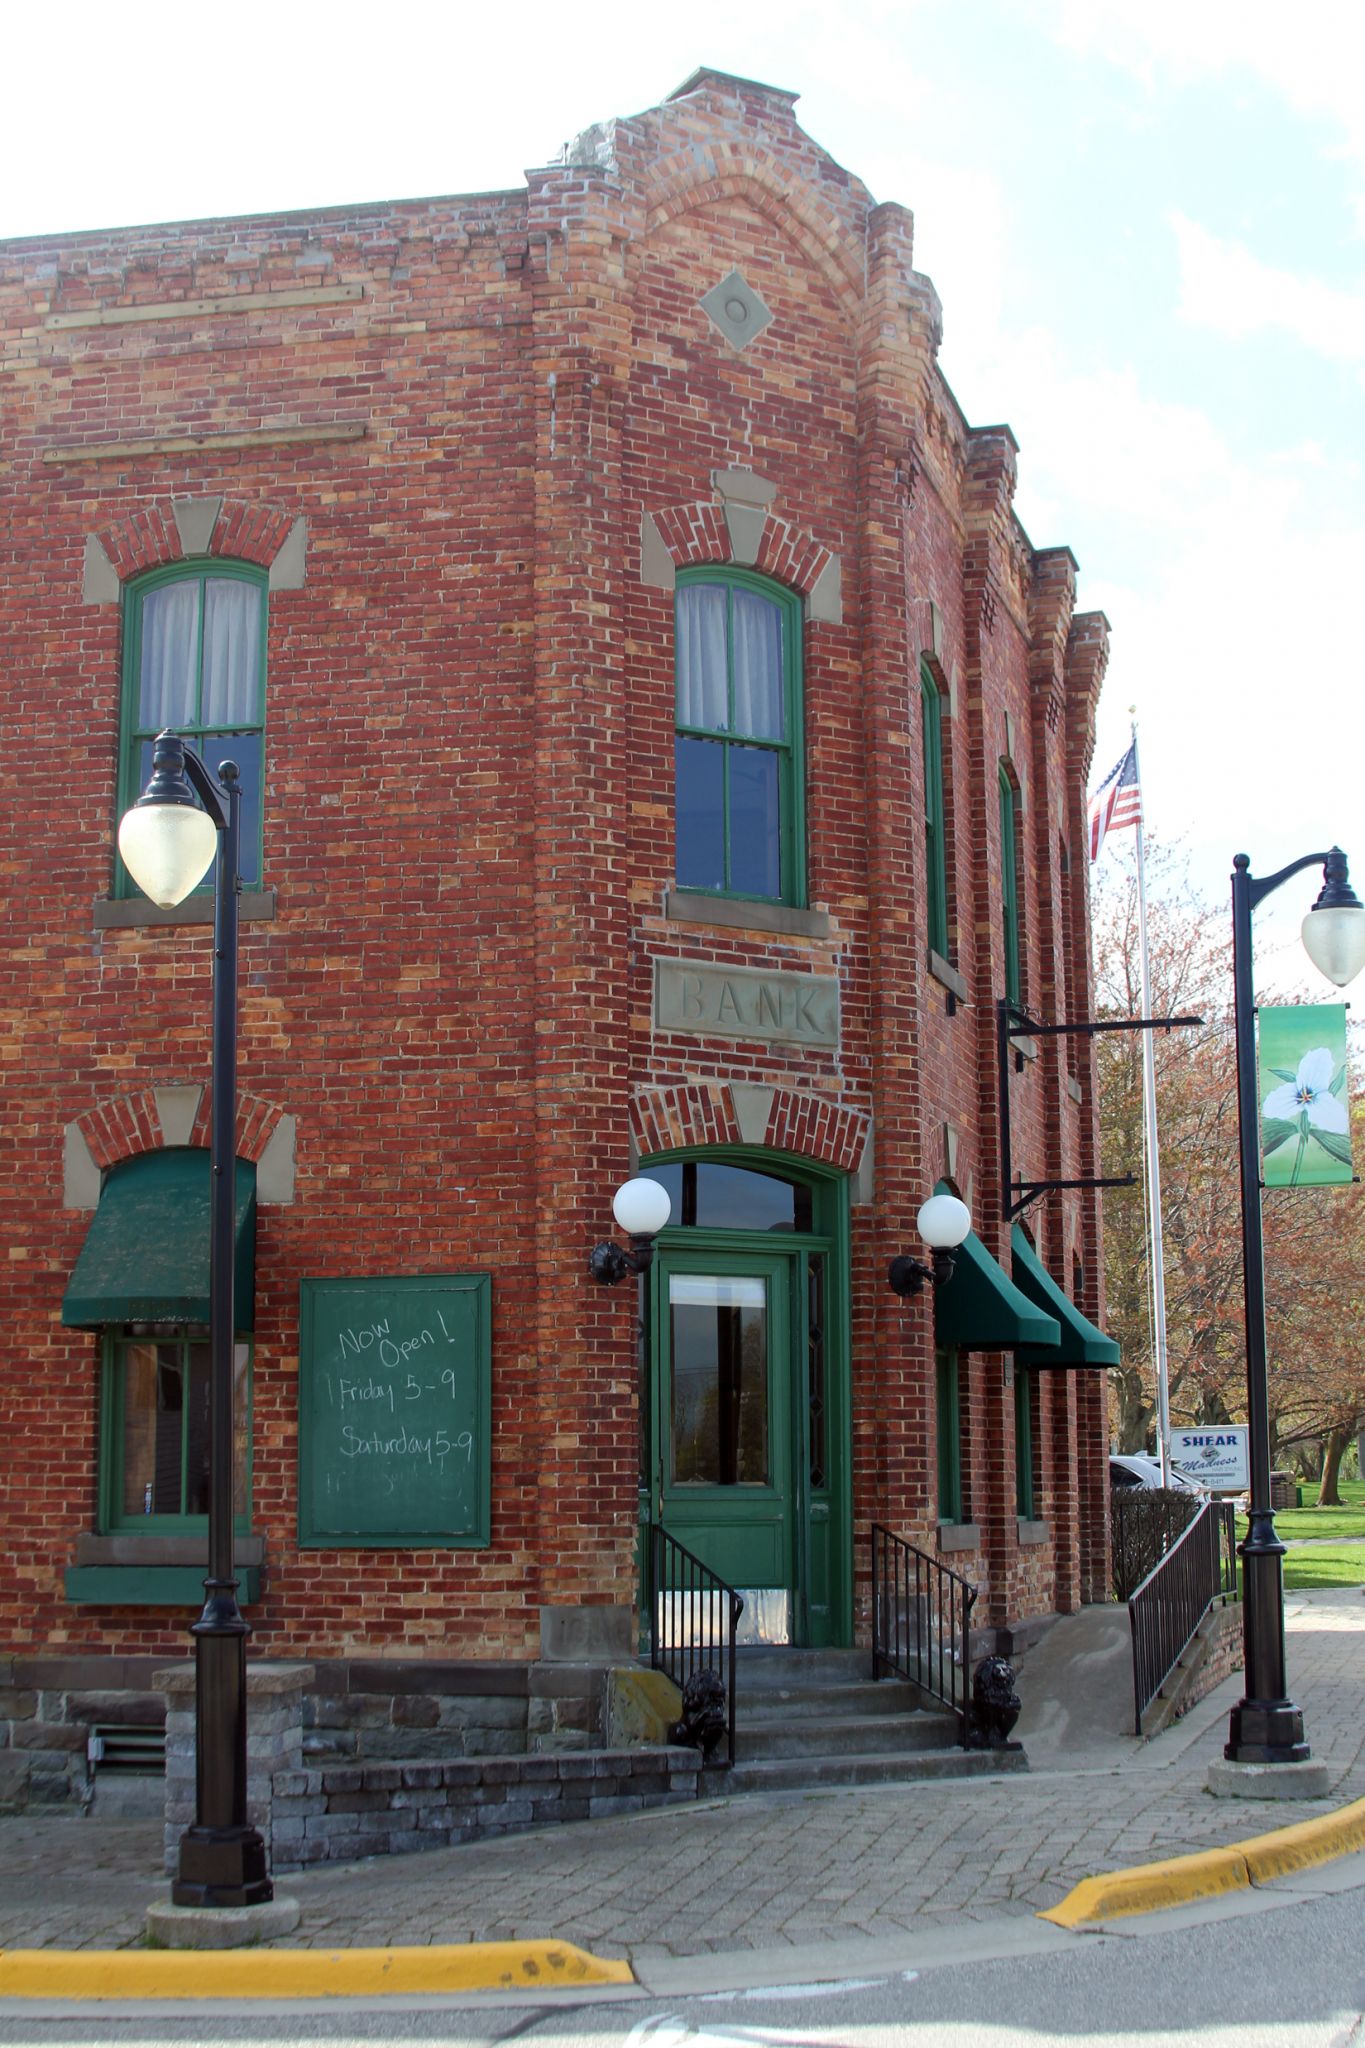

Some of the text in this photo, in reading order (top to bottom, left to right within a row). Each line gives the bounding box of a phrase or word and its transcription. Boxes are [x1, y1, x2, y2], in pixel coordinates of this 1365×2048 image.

[679, 971, 826, 1035] BANK
[339, 1377, 394, 1413] Friday
[339, 1425, 432, 1464] Saturday
[1182, 1435, 1238, 1447] SHEAR
[1182, 1456, 1238, 1471] Madness
